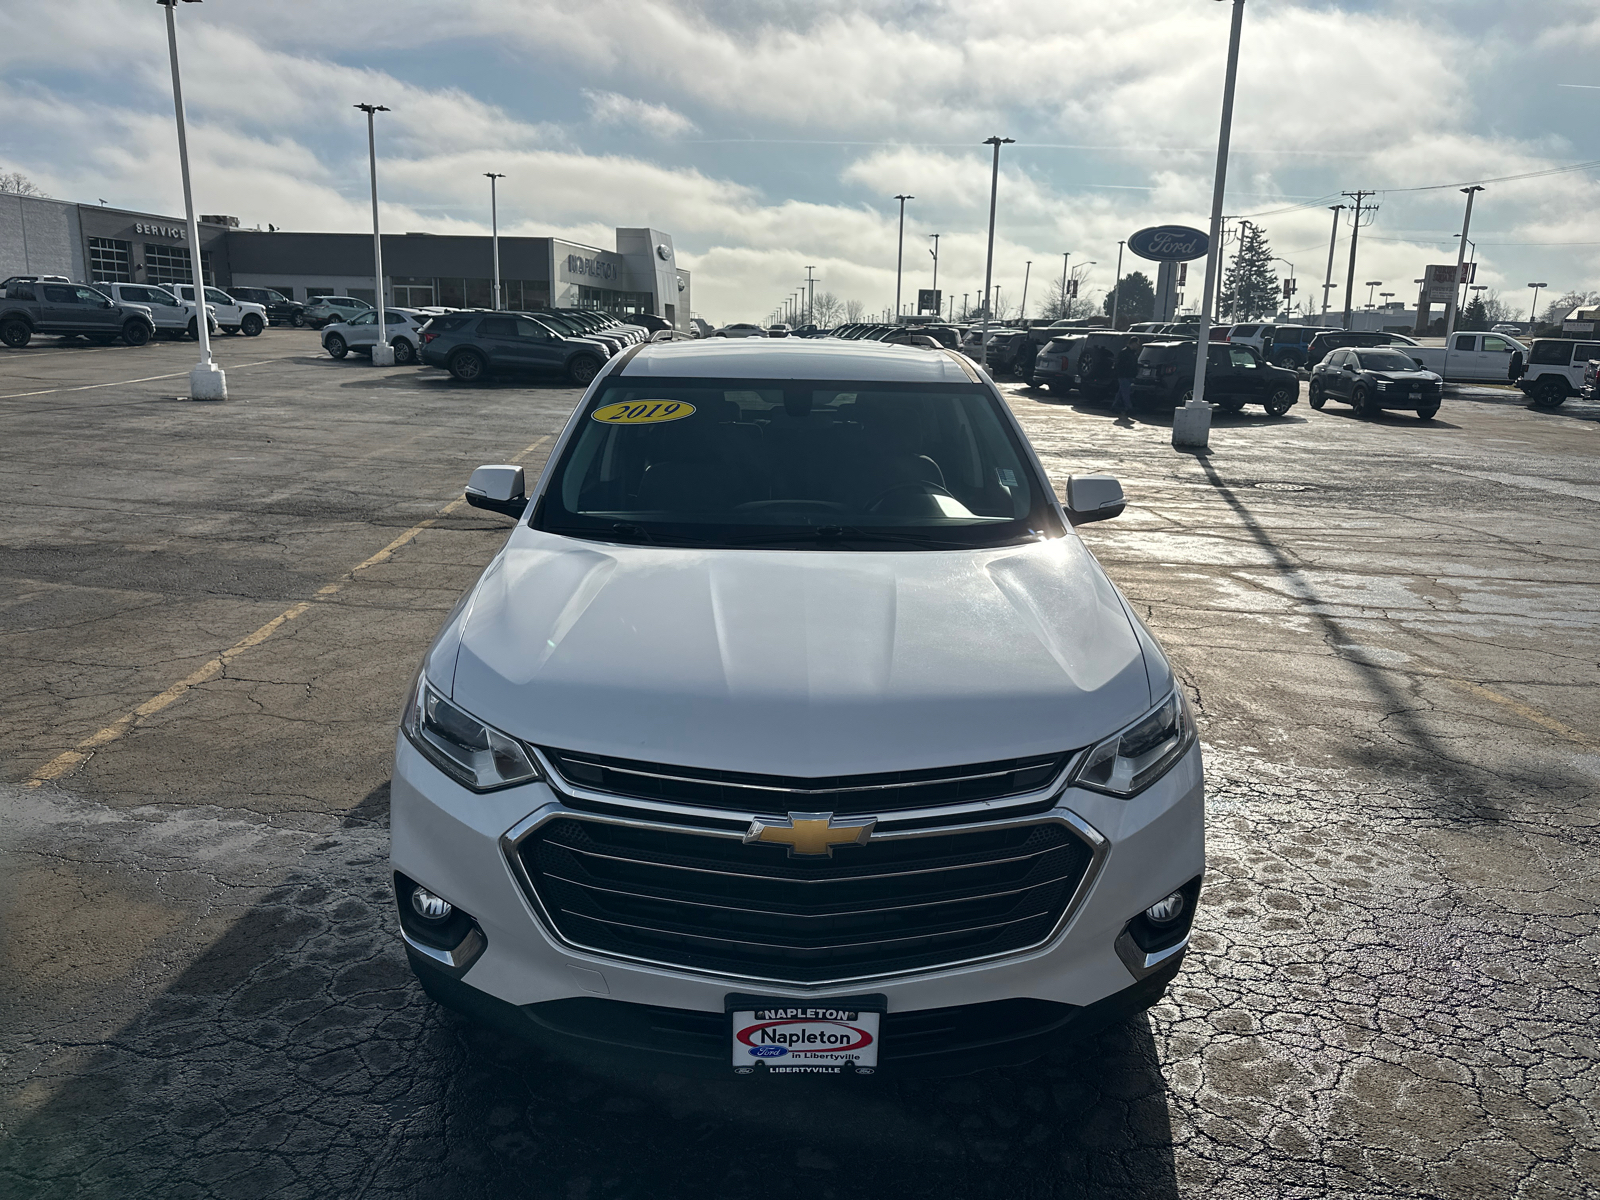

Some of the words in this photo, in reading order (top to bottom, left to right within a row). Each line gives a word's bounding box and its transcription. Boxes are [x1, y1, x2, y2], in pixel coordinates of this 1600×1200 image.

[136, 223, 186, 240] SERVICE
[1148, 231, 1198, 254] Ford
[568, 254, 618, 280] NAPLETON
[607, 403, 681, 420] 2019
[763, 1008, 850, 1021] NAPLETON
[760, 1028, 851, 1047] Napleton
[756, 1047, 781, 1057] Ford
[804, 1052, 861, 1060] Libertyville
